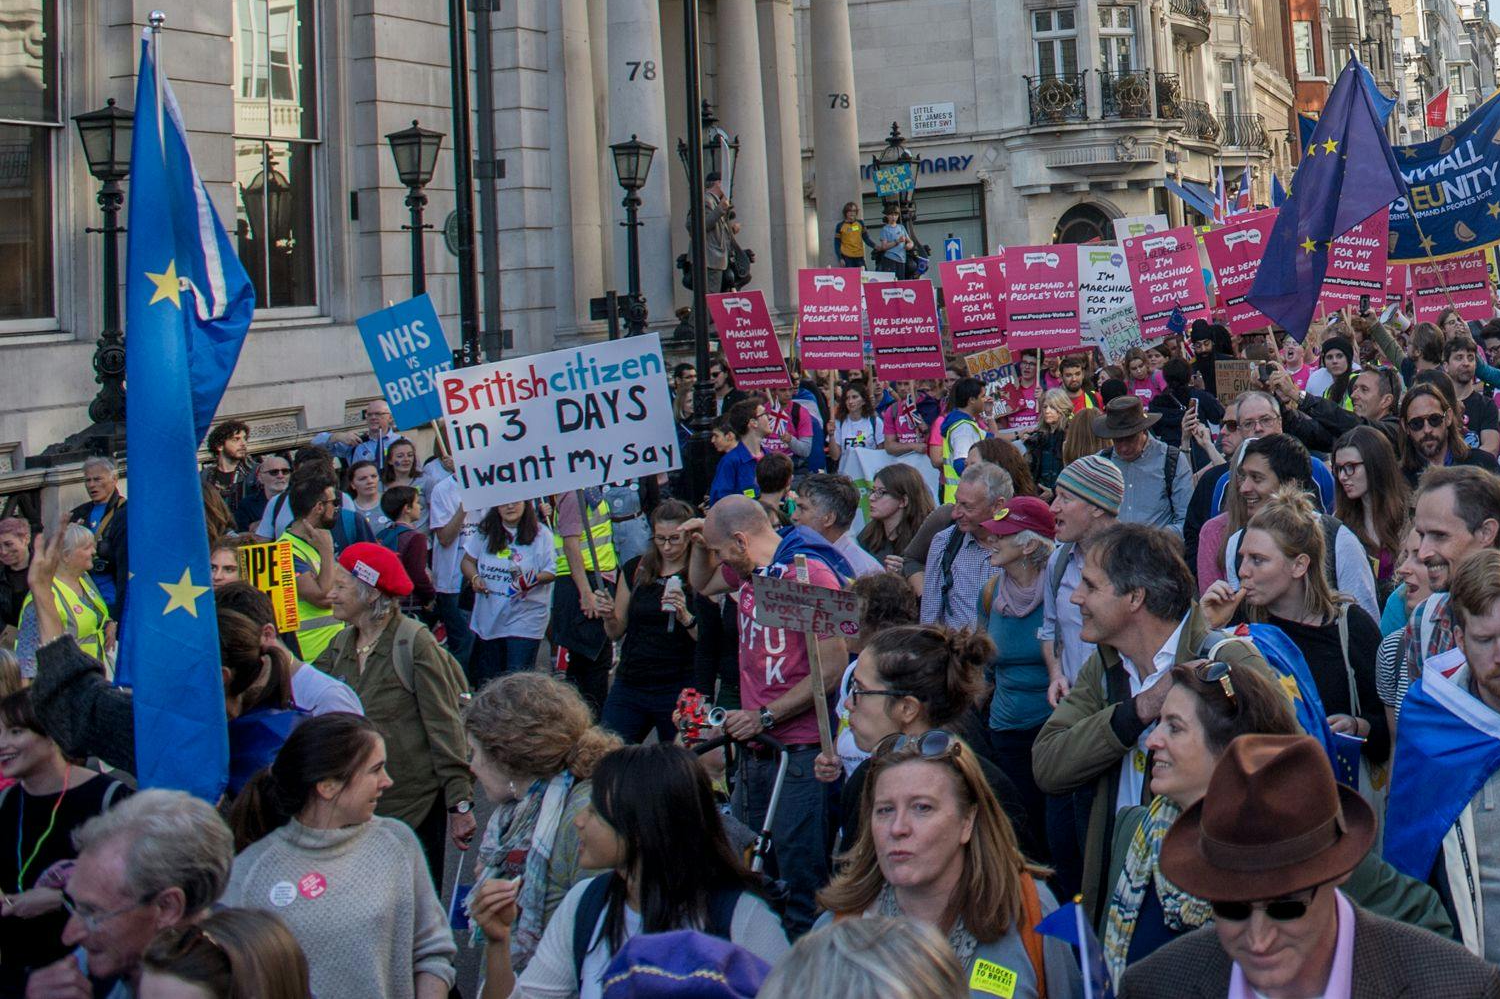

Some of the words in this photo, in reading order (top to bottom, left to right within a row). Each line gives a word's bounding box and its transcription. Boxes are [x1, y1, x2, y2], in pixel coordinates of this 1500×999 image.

[625, 60, 657, 82] 78
[828, 93, 851, 110] 78
[915, 121, 937, 130] STREET
[1477, 189, 1493, 201] VOTE
[1334, 236, 1380, 247] ARCHING
[1334, 248, 1353, 257] FOR
[1356, 250, 1372, 259] MY
[1155, 258, 1173, 268] I'M
[1219, 266, 1235, 276] WE
[1238, 259, 1262, 271] DEMA
[1334, 261, 1371, 272] FUTURE
[1460, 258, 1483, 269] VOTE
[1097, 272, 1114, 281] I'M
[1139, 265, 1193, 283] MARCHING
[1221, 269, 1258, 286] PEOPLE'
[967, 281, 984, 292] I'M
[1011, 283, 1028, 291] WE
[1030, 282, 1065, 290] DEMAND
[1079, 284, 1132, 293] MARCHING
[1150, 283, 1169, 293] FOR
[1173, 278, 1187, 288] MY
[953, 292, 992, 303] MARCHI
[1010, 291, 1051, 301] PEOPLE'S
[1054, 290, 1075, 299] VOTE
[1087, 295, 1107, 303] FOR
[1110, 295, 1125, 303] MY
[1152, 289, 1189, 304] FUTURE
[803, 305, 817, 313] WE
[962, 304, 981, 312] FOR
[735, 317, 752, 328] I'M
[803, 314, 838, 322] PEOPLE'S
[840, 314, 860, 322] VOTE
[873, 318, 892, 326] WE
[893, 317, 924, 325] DEMAND
[964, 312, 996, 323] FUTURE
[726, 328, 769, 339] MARCHING
[874, 325, 912, 335] PEOPLE'S
[914, 324, 935, 333] VOTE
[377, 320, 431, 363] NHS
[735, 340, 752, 349] FOR
[753, 339, 766, 348] MY
[739, 350, 769, 360] FUTURE
[385, 361, 453, 406] BREXIT
[443, 364, 548, 416] British
[550, 352, 662, 393] citizen
[453, 420, 489, 451] in
[501, 409, 527, 442] 3
[556, 385, 648, 434] DAYS
[460, 465, 471, 489] I
[474, 445, 556, 484] want
[569, 447, 614, 483] my
[832, 599, 855, 612] TO
[813, 610, 833, 621] AT
[978, 962, 1013, 980] BOLLOCKS
[988, 973, 1012, 986] BREXIT
